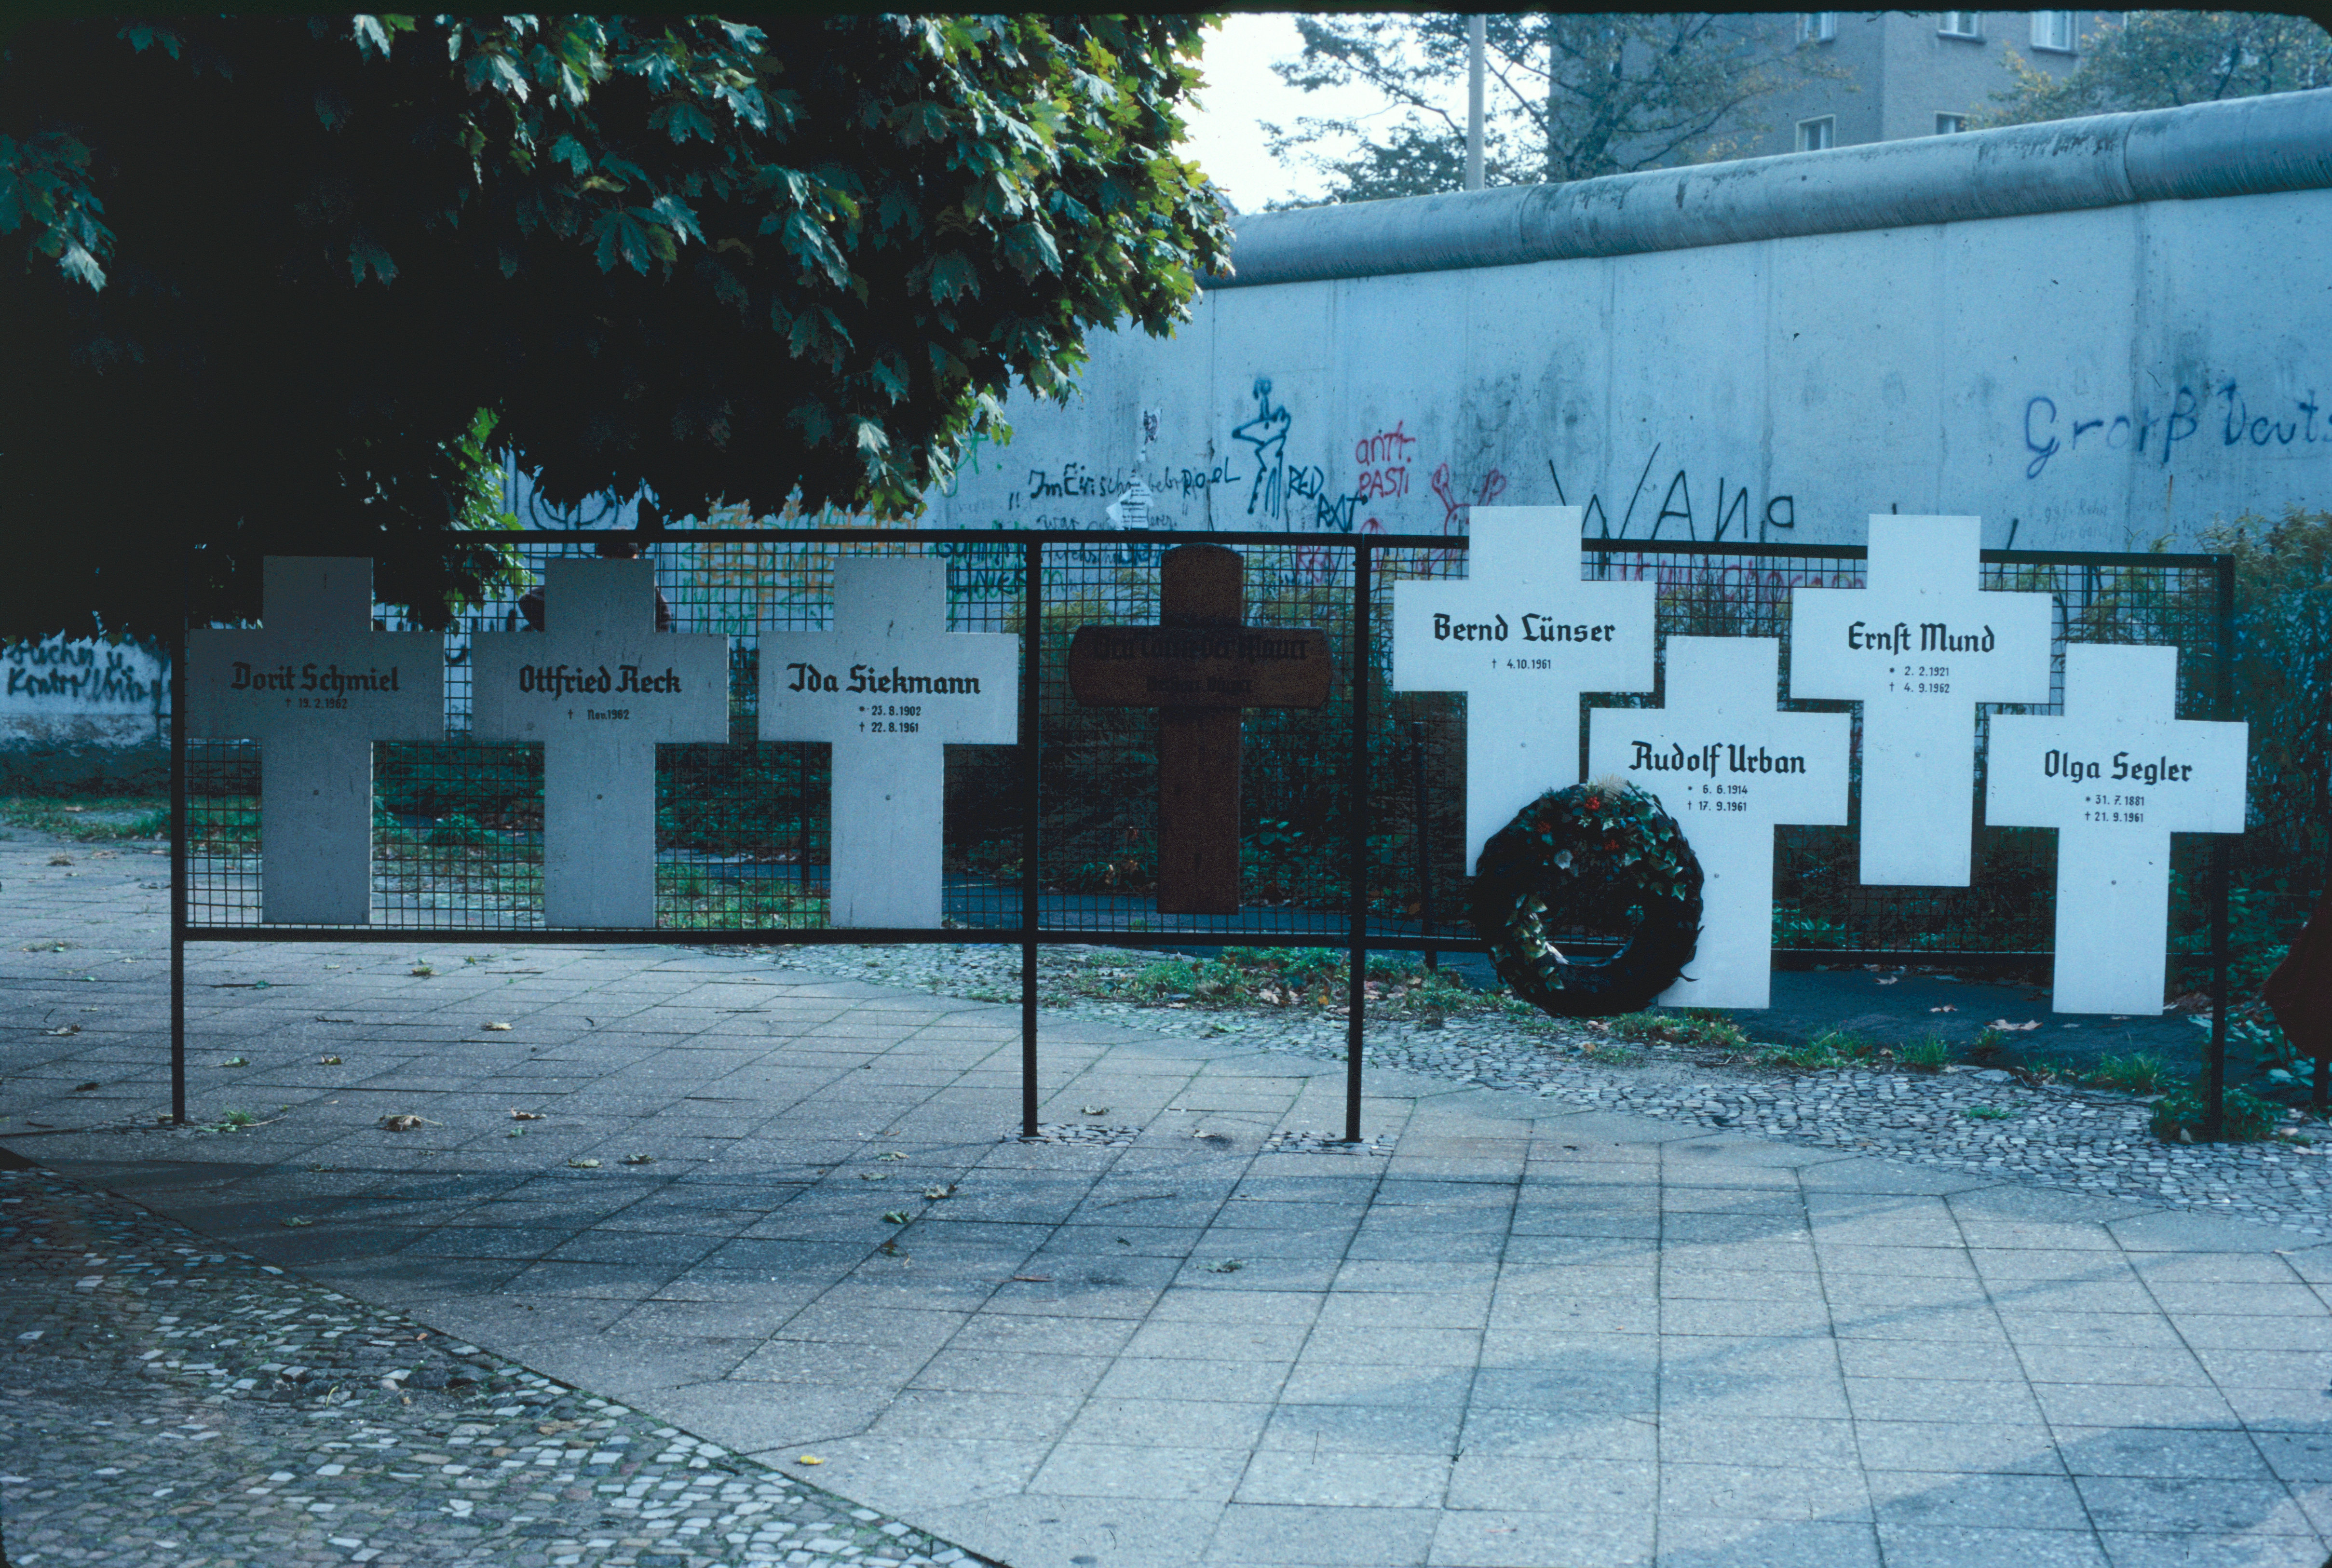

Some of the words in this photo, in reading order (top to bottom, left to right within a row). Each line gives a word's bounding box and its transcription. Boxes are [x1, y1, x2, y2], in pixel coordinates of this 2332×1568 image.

[1433, 612, 1508, 642] Bernd
[1521, 612, 1616, 643] Lünser
[1919, 622, 1995, 653] Mund
[230, 660, 297, 691] Dorit
[300, 662, 400, 698] Schmiel
[518, 663, 611, 701] Ottfried
[615, 663, 682, 694] Reck
[786, 662, 840, 693] Ida
[845, 663, 981, 694] Siekmann
[1628, 740, 1723, 778] Rudolf
[1727, 743, 1806, 774] Urban
[2044, 748, 2101, 784] Olga
[2111, 751, 2193, 786] Segler
